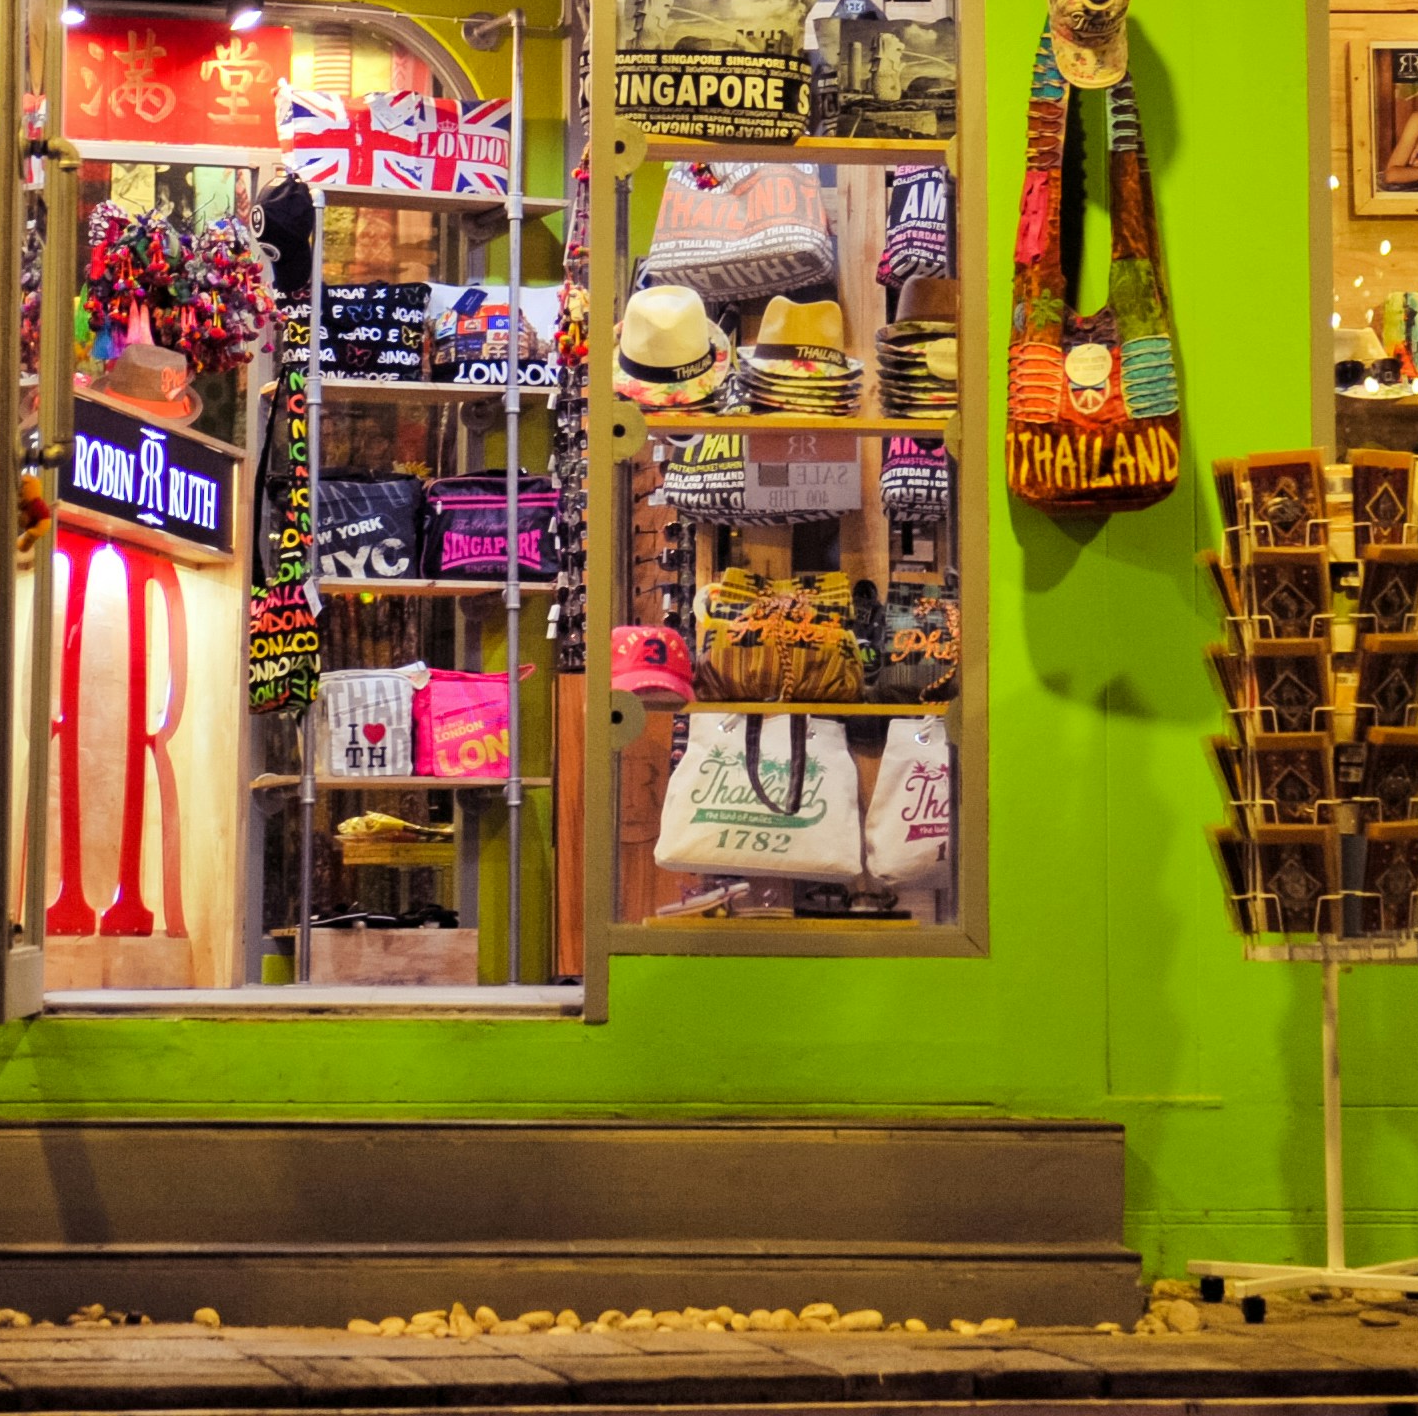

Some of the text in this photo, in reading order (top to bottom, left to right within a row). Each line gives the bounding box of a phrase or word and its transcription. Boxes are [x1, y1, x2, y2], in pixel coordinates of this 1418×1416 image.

[661, 54, 722, 66] SINGAPORE
[72, 434, 136, 504] ROBIN
[167, 466, 217, 530] RUTH
[336, 515, 384, 539] YORK
[441, 529, 542, 563] SINGAPRE
[643, 638, 668, 665] 3
[345, 746, 387, 769] TH
[690, 757, 827, 808] Thailad
[715, 828, 792, 854] 1782
